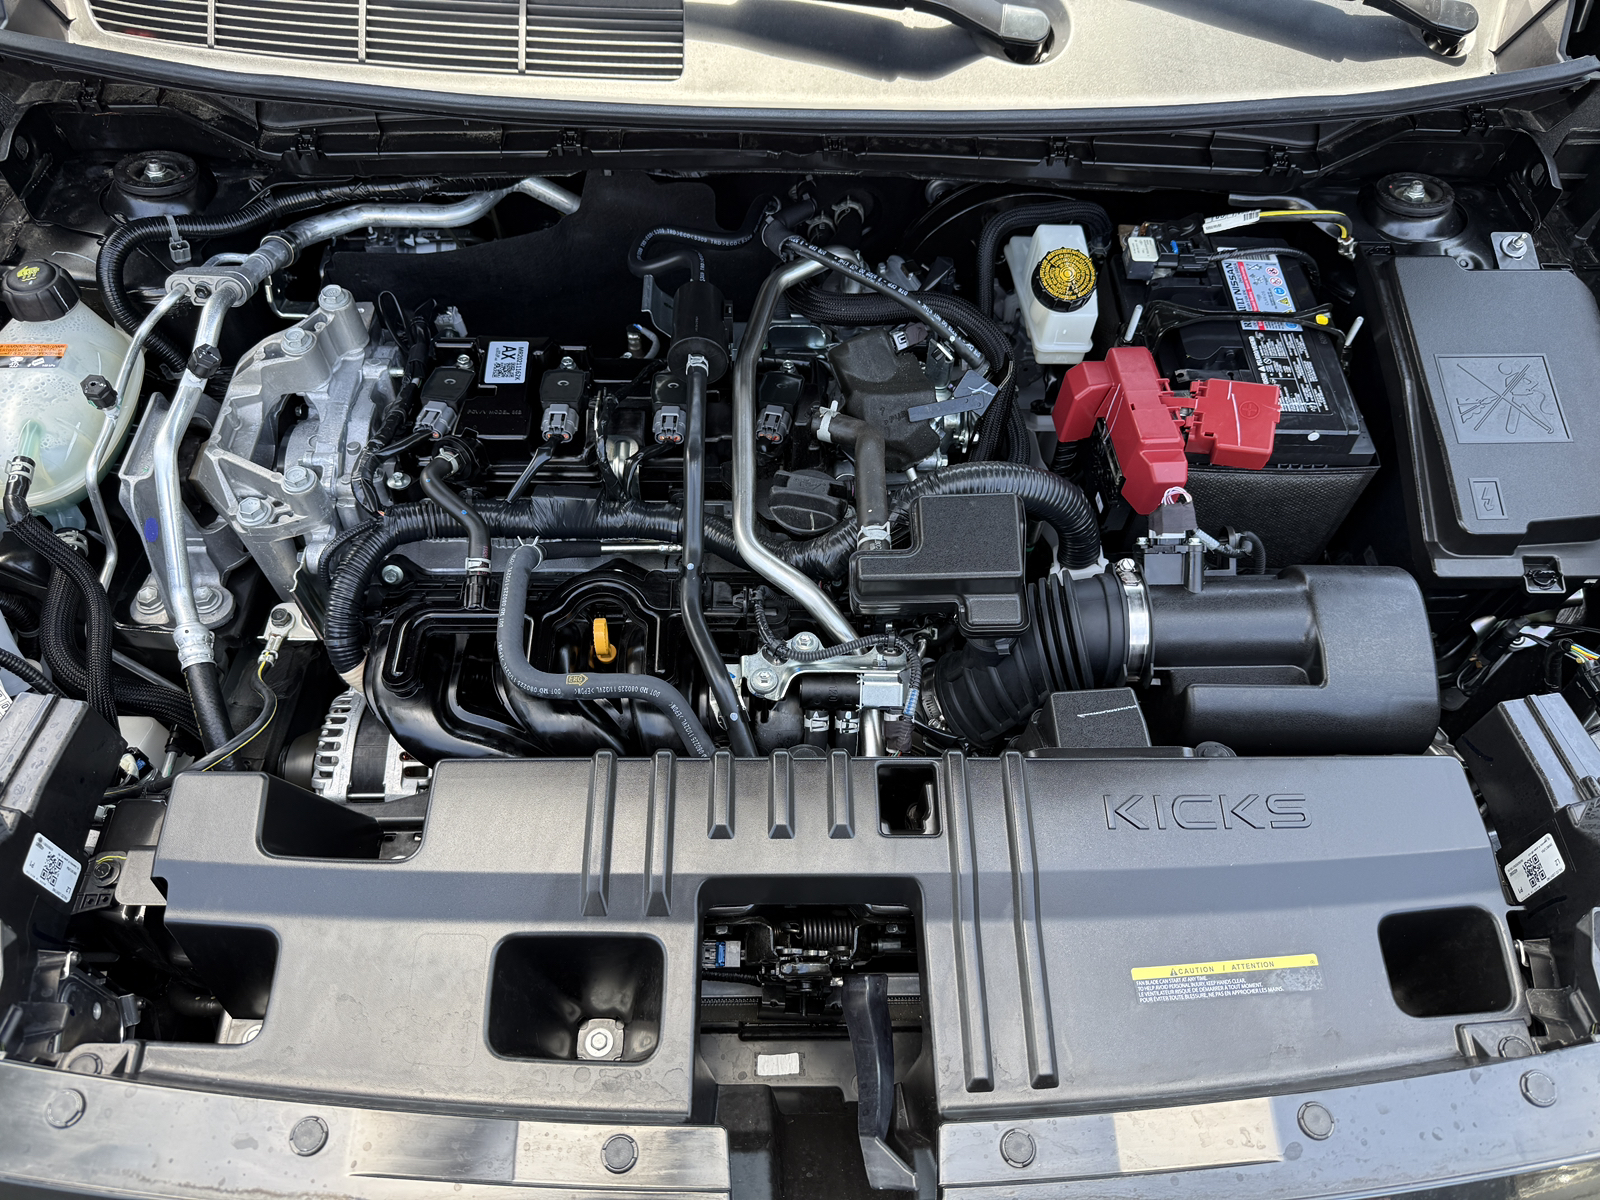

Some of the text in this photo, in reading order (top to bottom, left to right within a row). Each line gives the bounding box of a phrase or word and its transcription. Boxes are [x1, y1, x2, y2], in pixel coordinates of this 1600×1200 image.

[1224, 262, 1240, 295] NISSAN
[501, 345, 517, 360] AX
[1103, 794, 1312, 830] KICKS
[1177, 965, 1214, 974] CAUTION
[1231, 961, 1274, 970] ATTENTION
